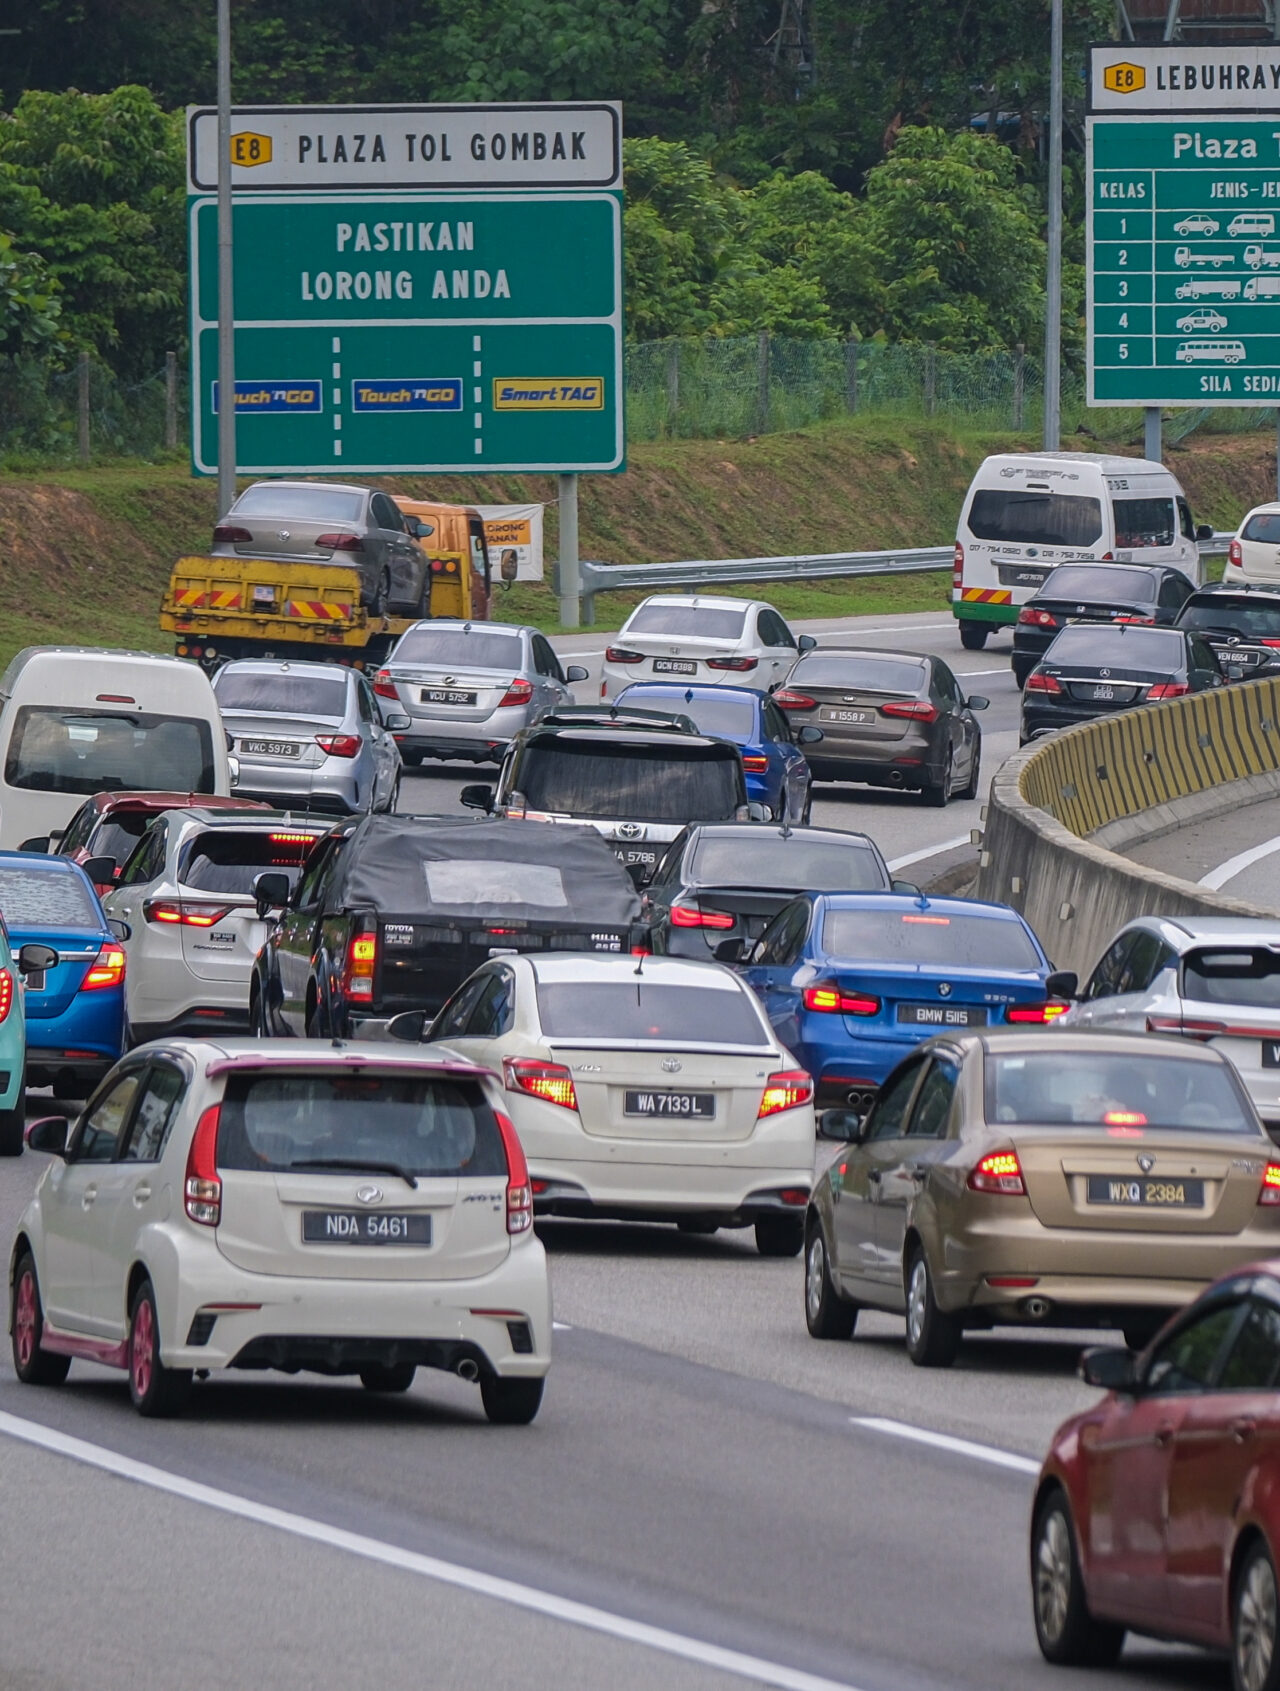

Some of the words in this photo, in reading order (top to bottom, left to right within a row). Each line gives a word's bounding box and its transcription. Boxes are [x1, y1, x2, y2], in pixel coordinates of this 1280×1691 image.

[1116, 70, 1133, 86] E8
[236, 138, 261, 160] E8
[299, 134, 386, 163] PLAZA
[406, 133, 451, 162] TOL
[471, 132, 586, 161] GOMBAK
[1174, 134, 1257, 159] Plaza
[1100, 182, 1145, 199] KELAS
[1120, 218, 1126, 234] 1
[337, 221, 474, 252] PASTIKAN
[1118, 250, 1127, 265] 2
[301, 271, 412, 300] LORONG
[432, 269, 511, 298] ANDA
[1118, 281, 1127, 297] 3
[1118, 312, 1128, 328] 4
[1119, 344, 1128, 359] 5
[1200, 375, 1231, 393] SILA
[429, 691, 445, 701] VCU
[448, 693, 468, 702] 5752
[248, 743, 266, 752] VKC
[267, 744, 292, 755] 5973
[628, 851, 655, 863] 5786
[917, 1008, 943, 1022] BMW
[1109, 1182, 1140, 1201] WXQ
[1146, 1183, 1185, 1203] 2384
[326, 1215, 359, 1235] NDA
[367, 1216, 408, 1236] 5461
